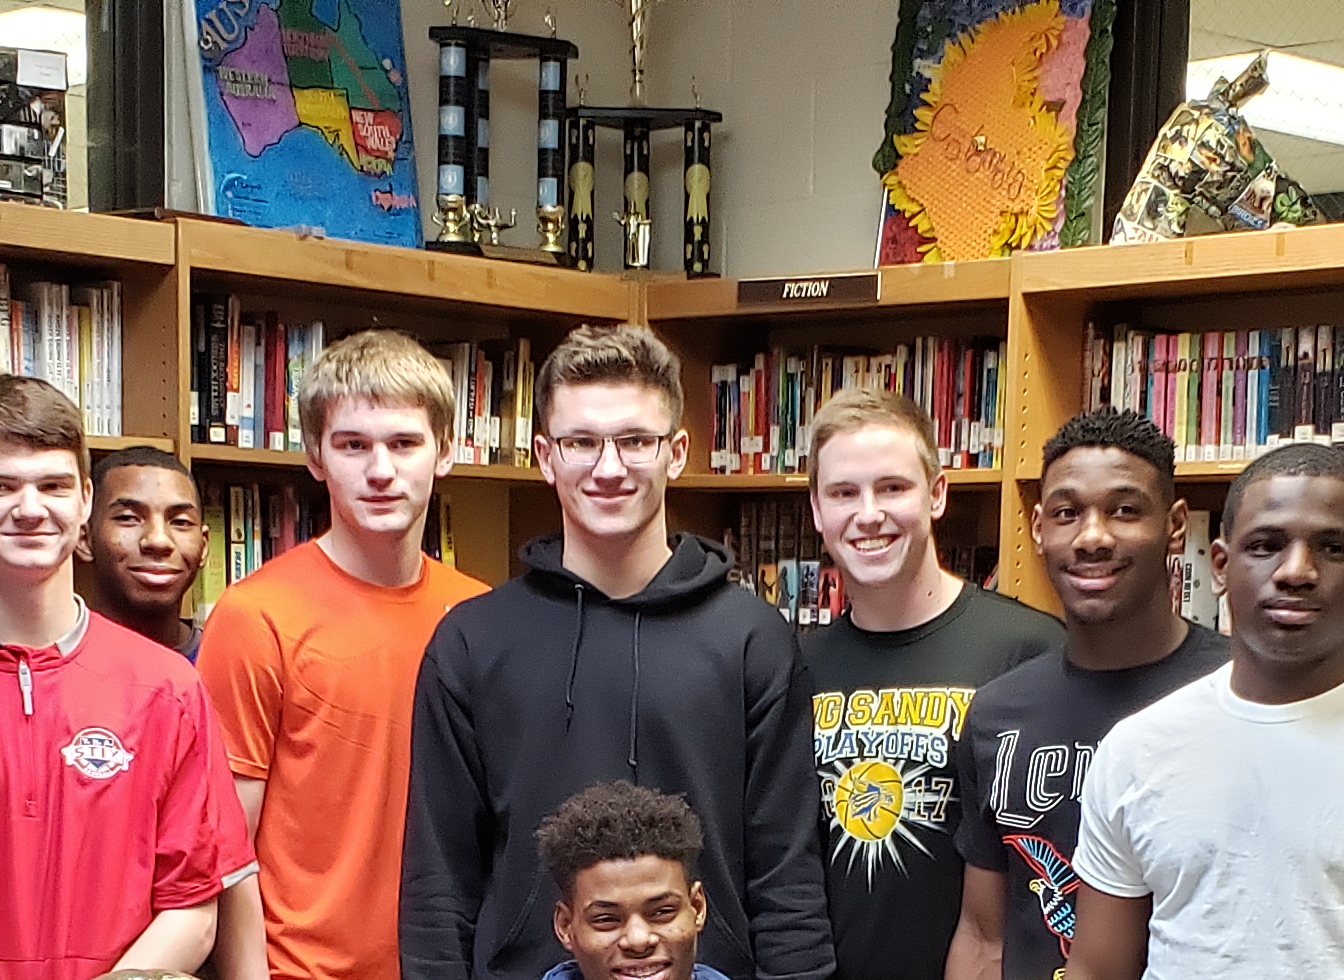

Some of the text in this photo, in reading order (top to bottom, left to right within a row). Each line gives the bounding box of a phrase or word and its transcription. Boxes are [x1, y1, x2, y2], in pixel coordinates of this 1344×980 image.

[352, 110, 374, 125] NEW
[358, 123, 391, 141] SOUTH
[782, 280, 829, 299] FICTION
[845, 686, 977, 743] SANDY
[906, 778, 954, 823] 17
